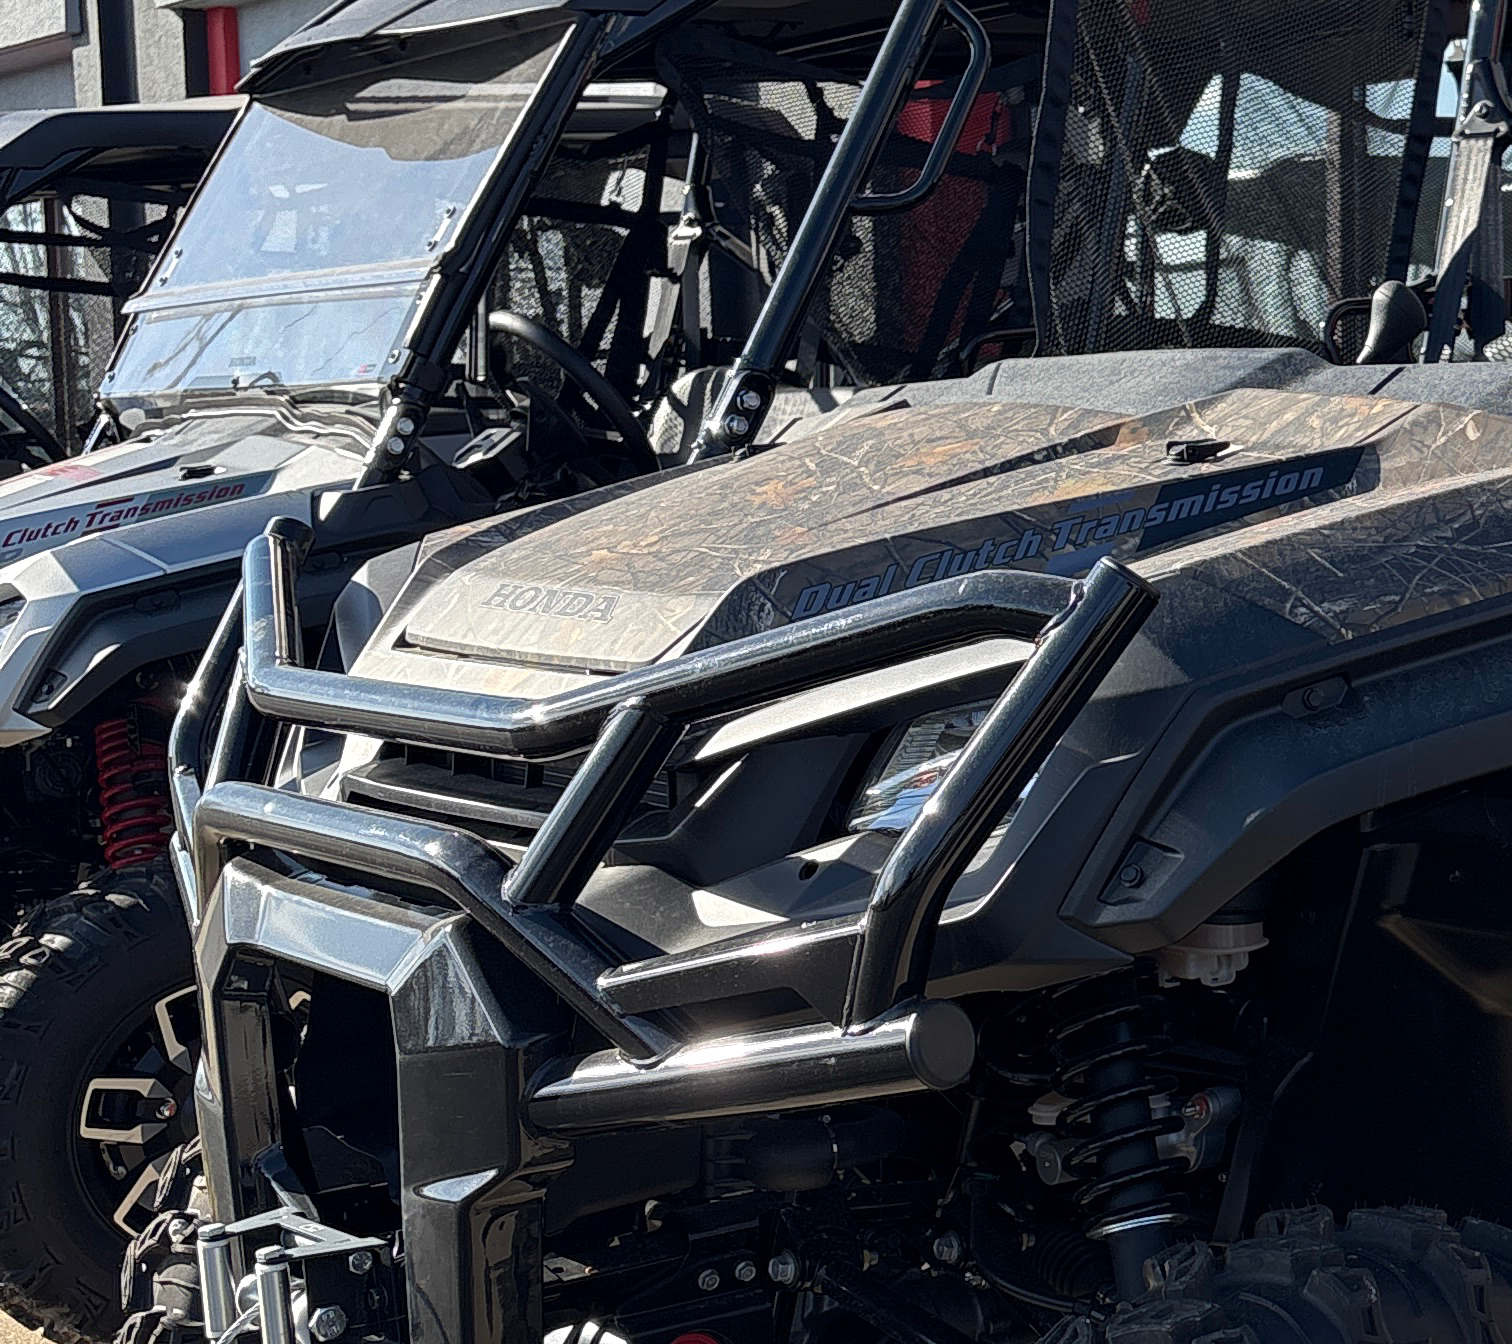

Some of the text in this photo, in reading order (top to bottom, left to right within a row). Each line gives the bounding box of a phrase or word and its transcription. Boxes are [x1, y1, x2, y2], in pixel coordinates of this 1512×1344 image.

[1, 482, 247, 549] Clutch Transmission
[789, 464, 1325, 622] Dual Clutch Transmission
[480, 583, 620, 624] HONDA
